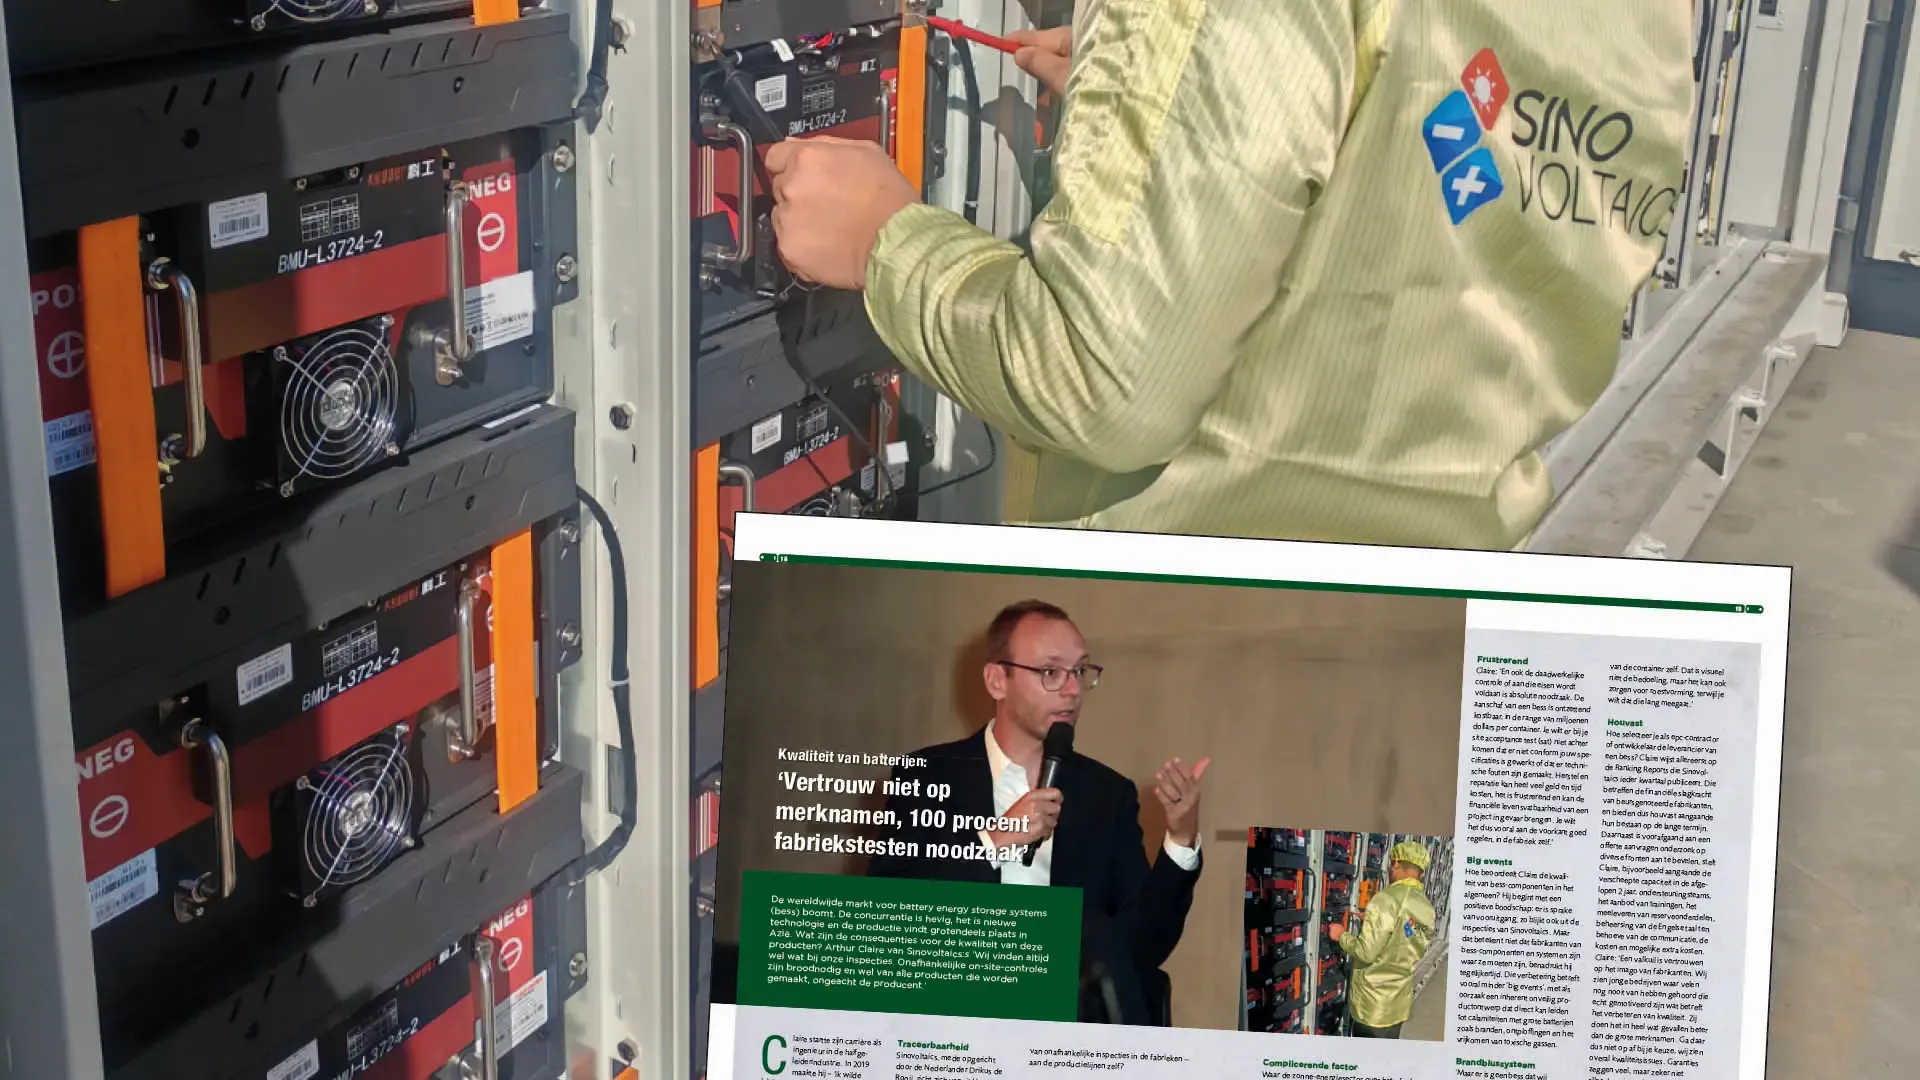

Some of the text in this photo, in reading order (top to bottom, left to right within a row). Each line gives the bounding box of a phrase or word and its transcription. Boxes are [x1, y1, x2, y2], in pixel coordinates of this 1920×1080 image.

[1511, 89, 1633, 163] SINO
[467, 172, 512, 200] NEG
[277, 230, 384, 274] BMU-L3724-2
[31, 283, 82, 316] PO
[301, 648, 400, 712] BMU-L3724-2
[75, 737, 136, 784] NEG
[489, 899, 528, 938] NEG
[332, 1016, 419, 1080] MU-L3724-2
